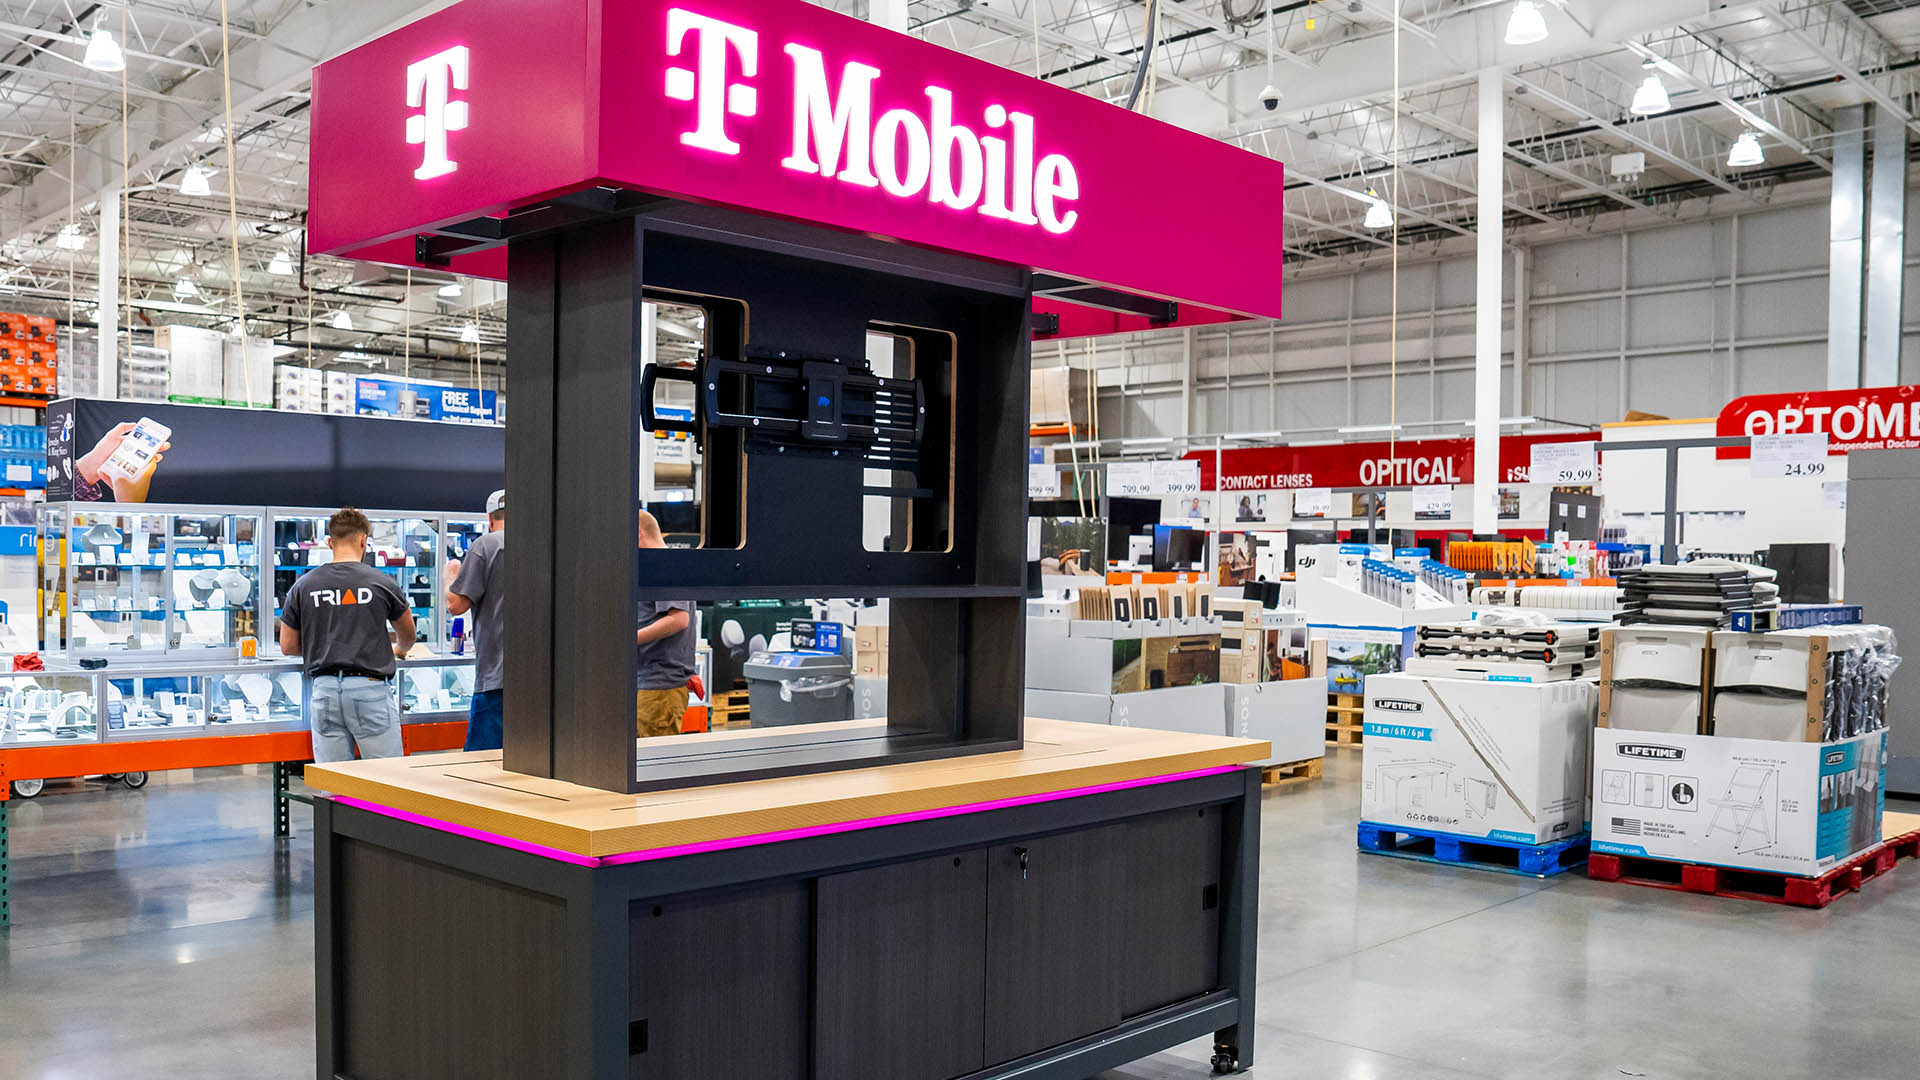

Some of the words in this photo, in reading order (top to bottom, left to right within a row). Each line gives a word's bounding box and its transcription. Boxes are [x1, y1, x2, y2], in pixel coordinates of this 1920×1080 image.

[781, 42, 1081, 235] Mobile
[442, 390, 469, 406] FREE
[1828, 441, 1884, 451] ndependent
[1359, 456, 1461, 486] OPTICAL
[1558, 469, 1592, 481] 59.99
[1784, 462, 1825, 476] 24.99
[1220, 474, 1268, 490] CONTACT
[1270, 473, 1313, 488] LENSES
[1121, 484, 1150, 494] 799.99
[20, 530, 55, 552] rig
[309, 587, 373, 608] TRIAD
[1379, 700, 1418, 711] LIFETIME
[1624, 746, 1677, 758] LIFETIME
[1598, 844, 1641, 854] lifetime.com
